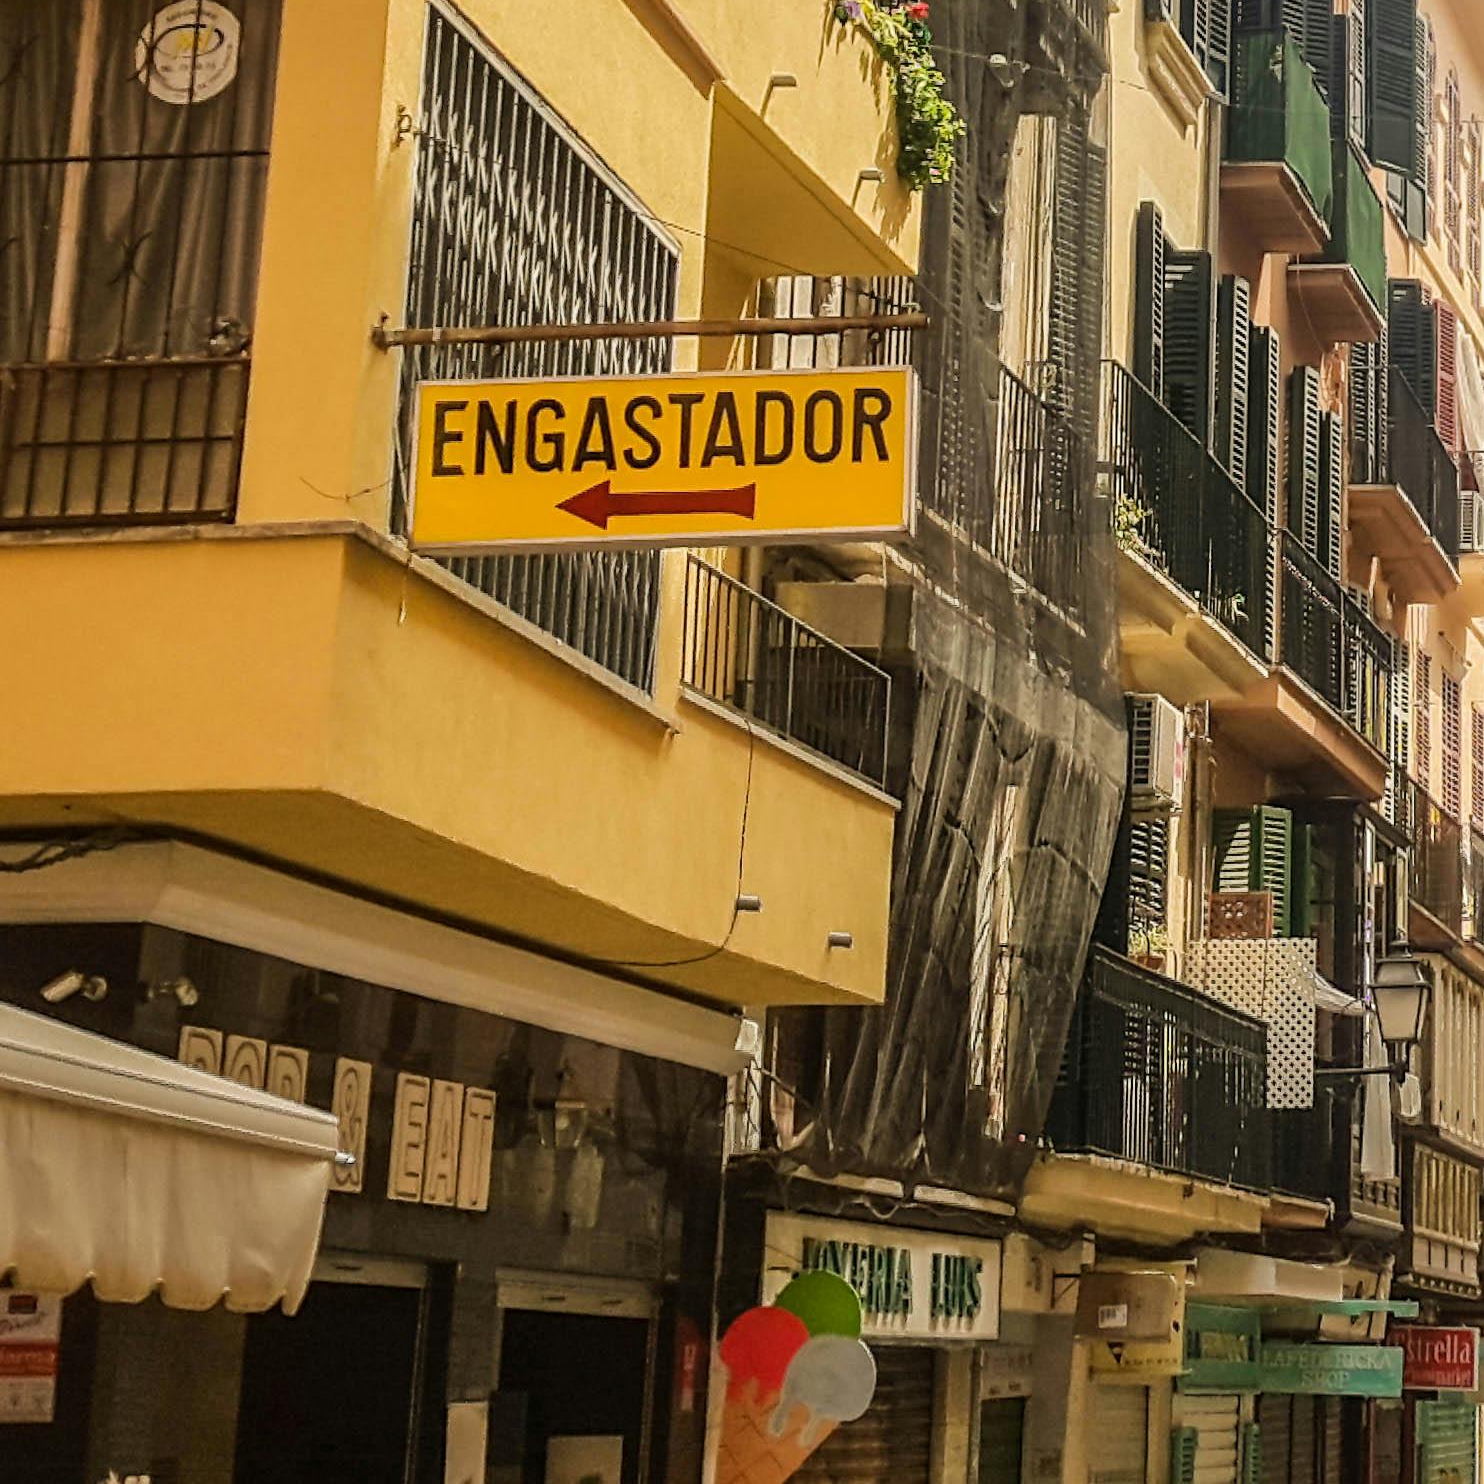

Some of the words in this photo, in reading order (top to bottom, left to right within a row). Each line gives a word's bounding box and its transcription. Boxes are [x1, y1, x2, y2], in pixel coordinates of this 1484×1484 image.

[432, 387, 893, 477] ENGASTADOR
[390, 1074, 495, 1209] EAT
[1400, 1333, 1472, 1365] strella
